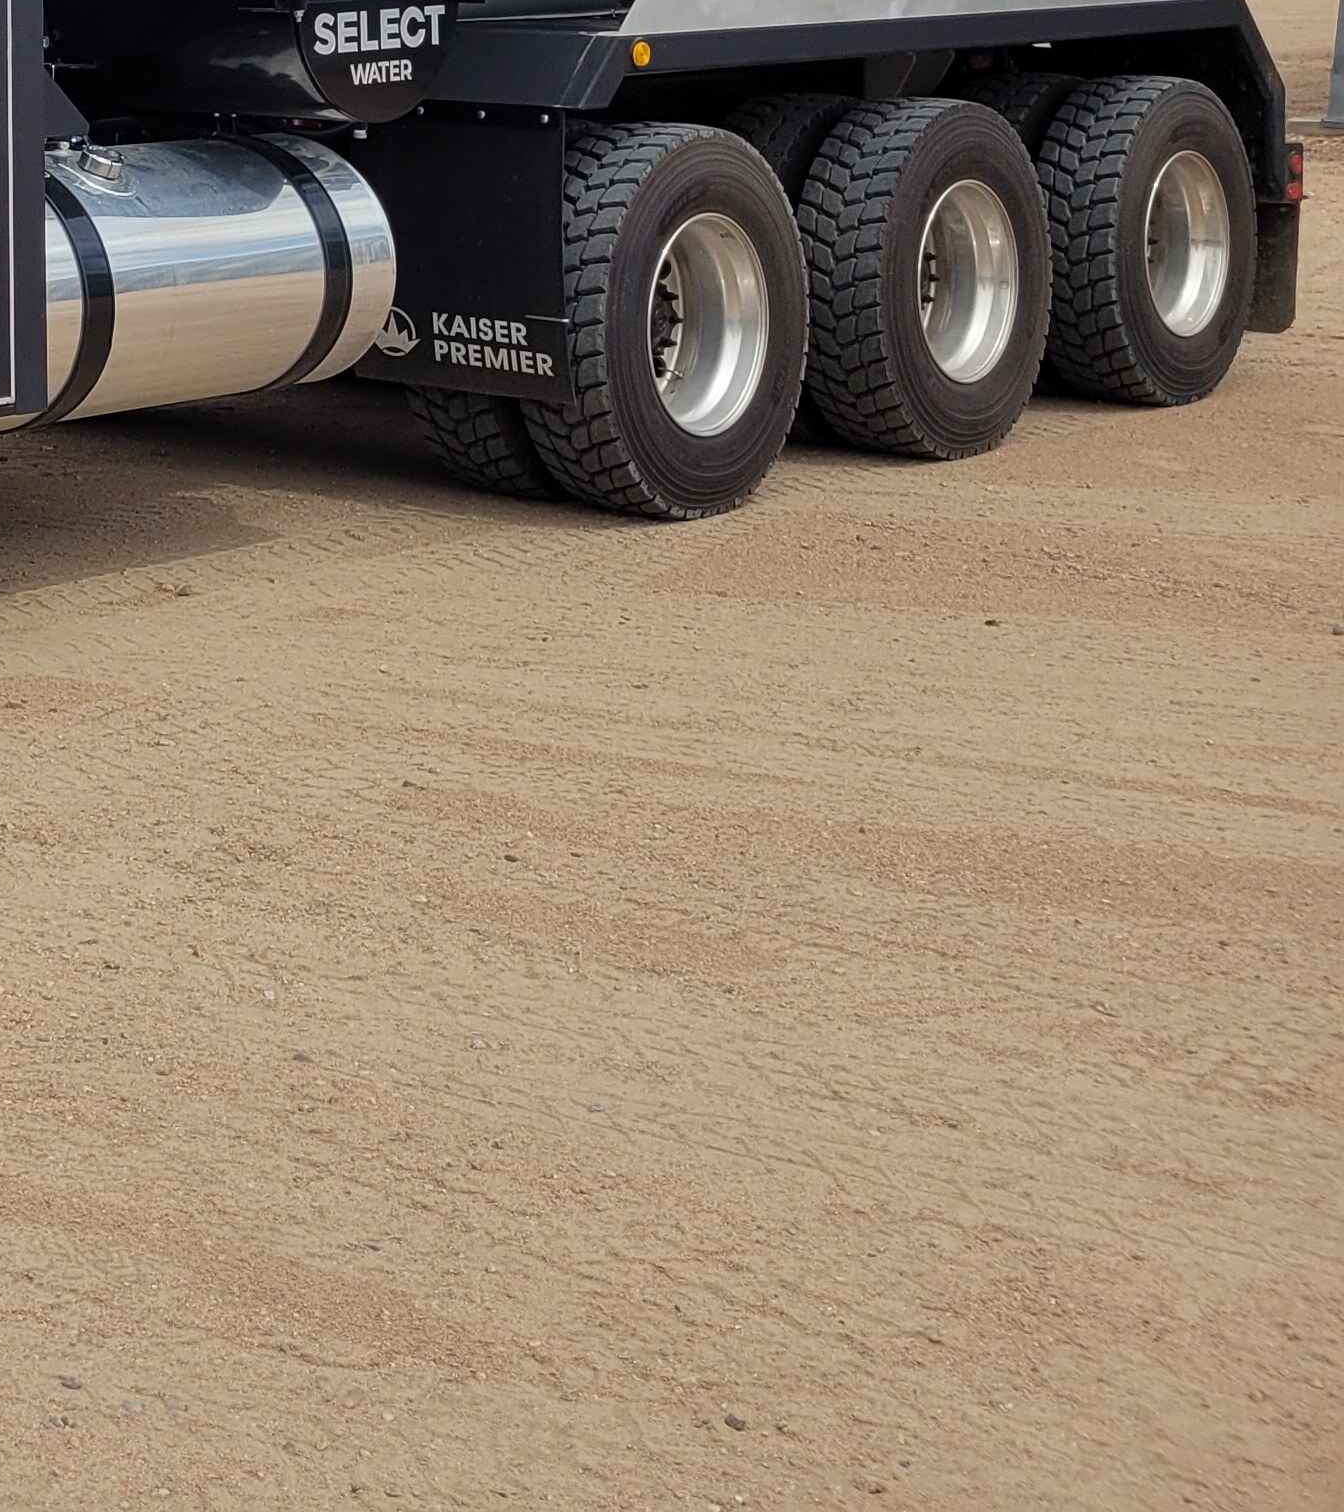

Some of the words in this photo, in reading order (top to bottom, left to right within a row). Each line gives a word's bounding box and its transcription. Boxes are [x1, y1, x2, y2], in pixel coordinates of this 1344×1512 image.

[313, 4, 446, 56] SELECT
[349, 59, 413, 86] WATER
[432, 311, 529, 347] KAISER
[433, 339, 555, 377] PREMIER
